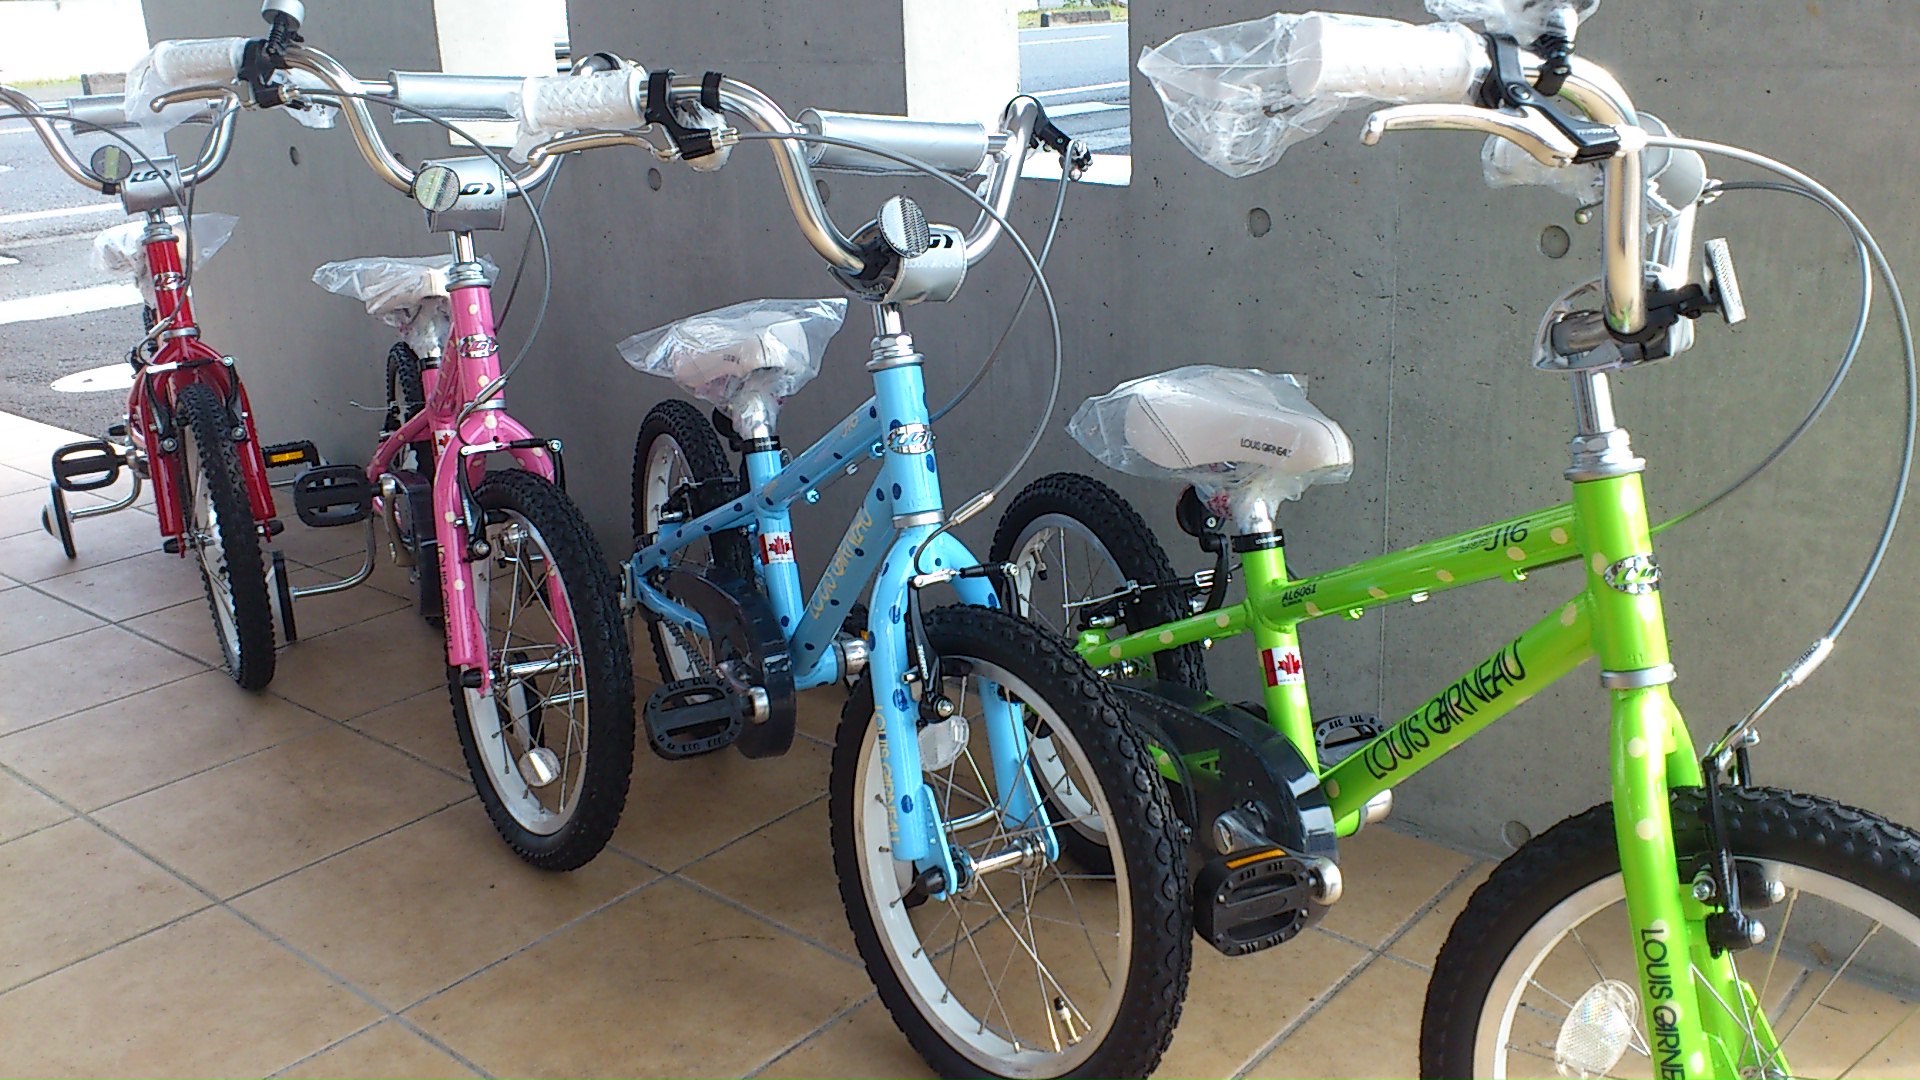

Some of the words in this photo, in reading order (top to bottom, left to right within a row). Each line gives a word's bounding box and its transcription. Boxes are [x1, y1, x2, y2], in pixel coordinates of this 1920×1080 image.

[1483, 519, 1531, 552] J16
[1281, 583, 1317, 601] AL6061
[1364, 713, 1431, 780] LOUIS
[1424, 635, 1527, 735] GARNEAU
[1641, 927, 1674, 1000] LOUIS
